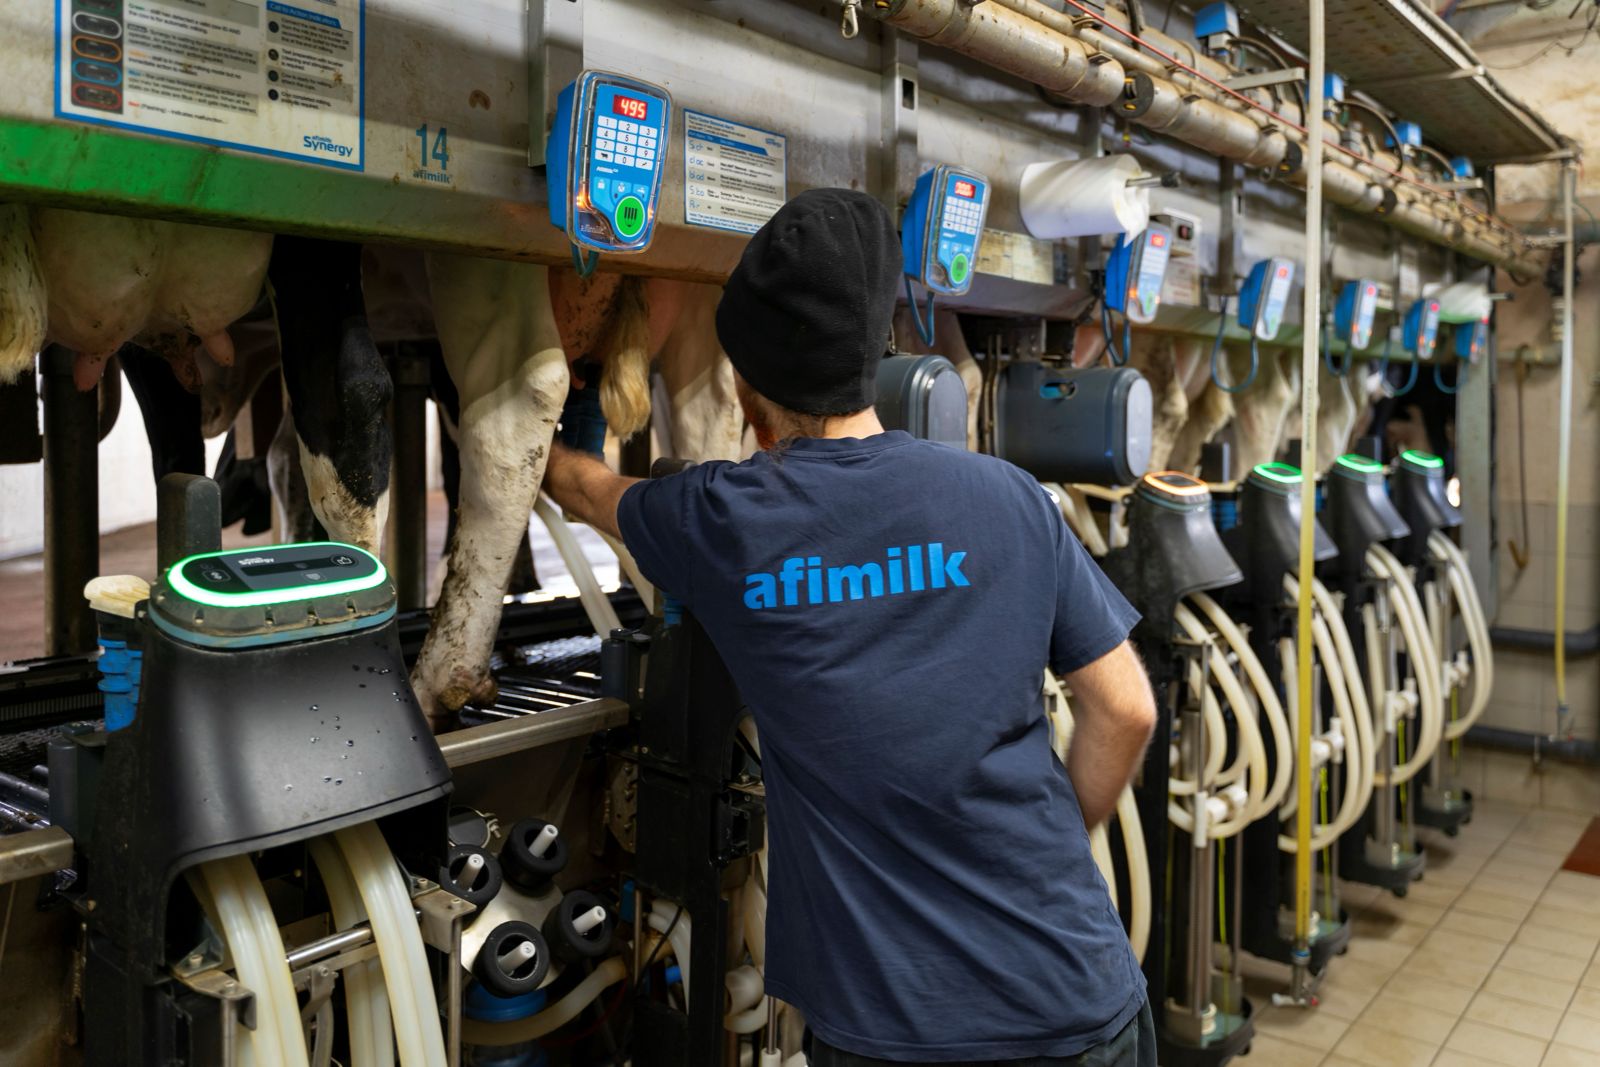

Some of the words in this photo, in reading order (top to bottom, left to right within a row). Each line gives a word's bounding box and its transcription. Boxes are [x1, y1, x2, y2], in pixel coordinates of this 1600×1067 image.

[621, 98, 647, 118] 495
[304, 136, 353, 157] Synergy
[415, 123, 449, 170] 14
[743, 542, 971, 610] afimilk
